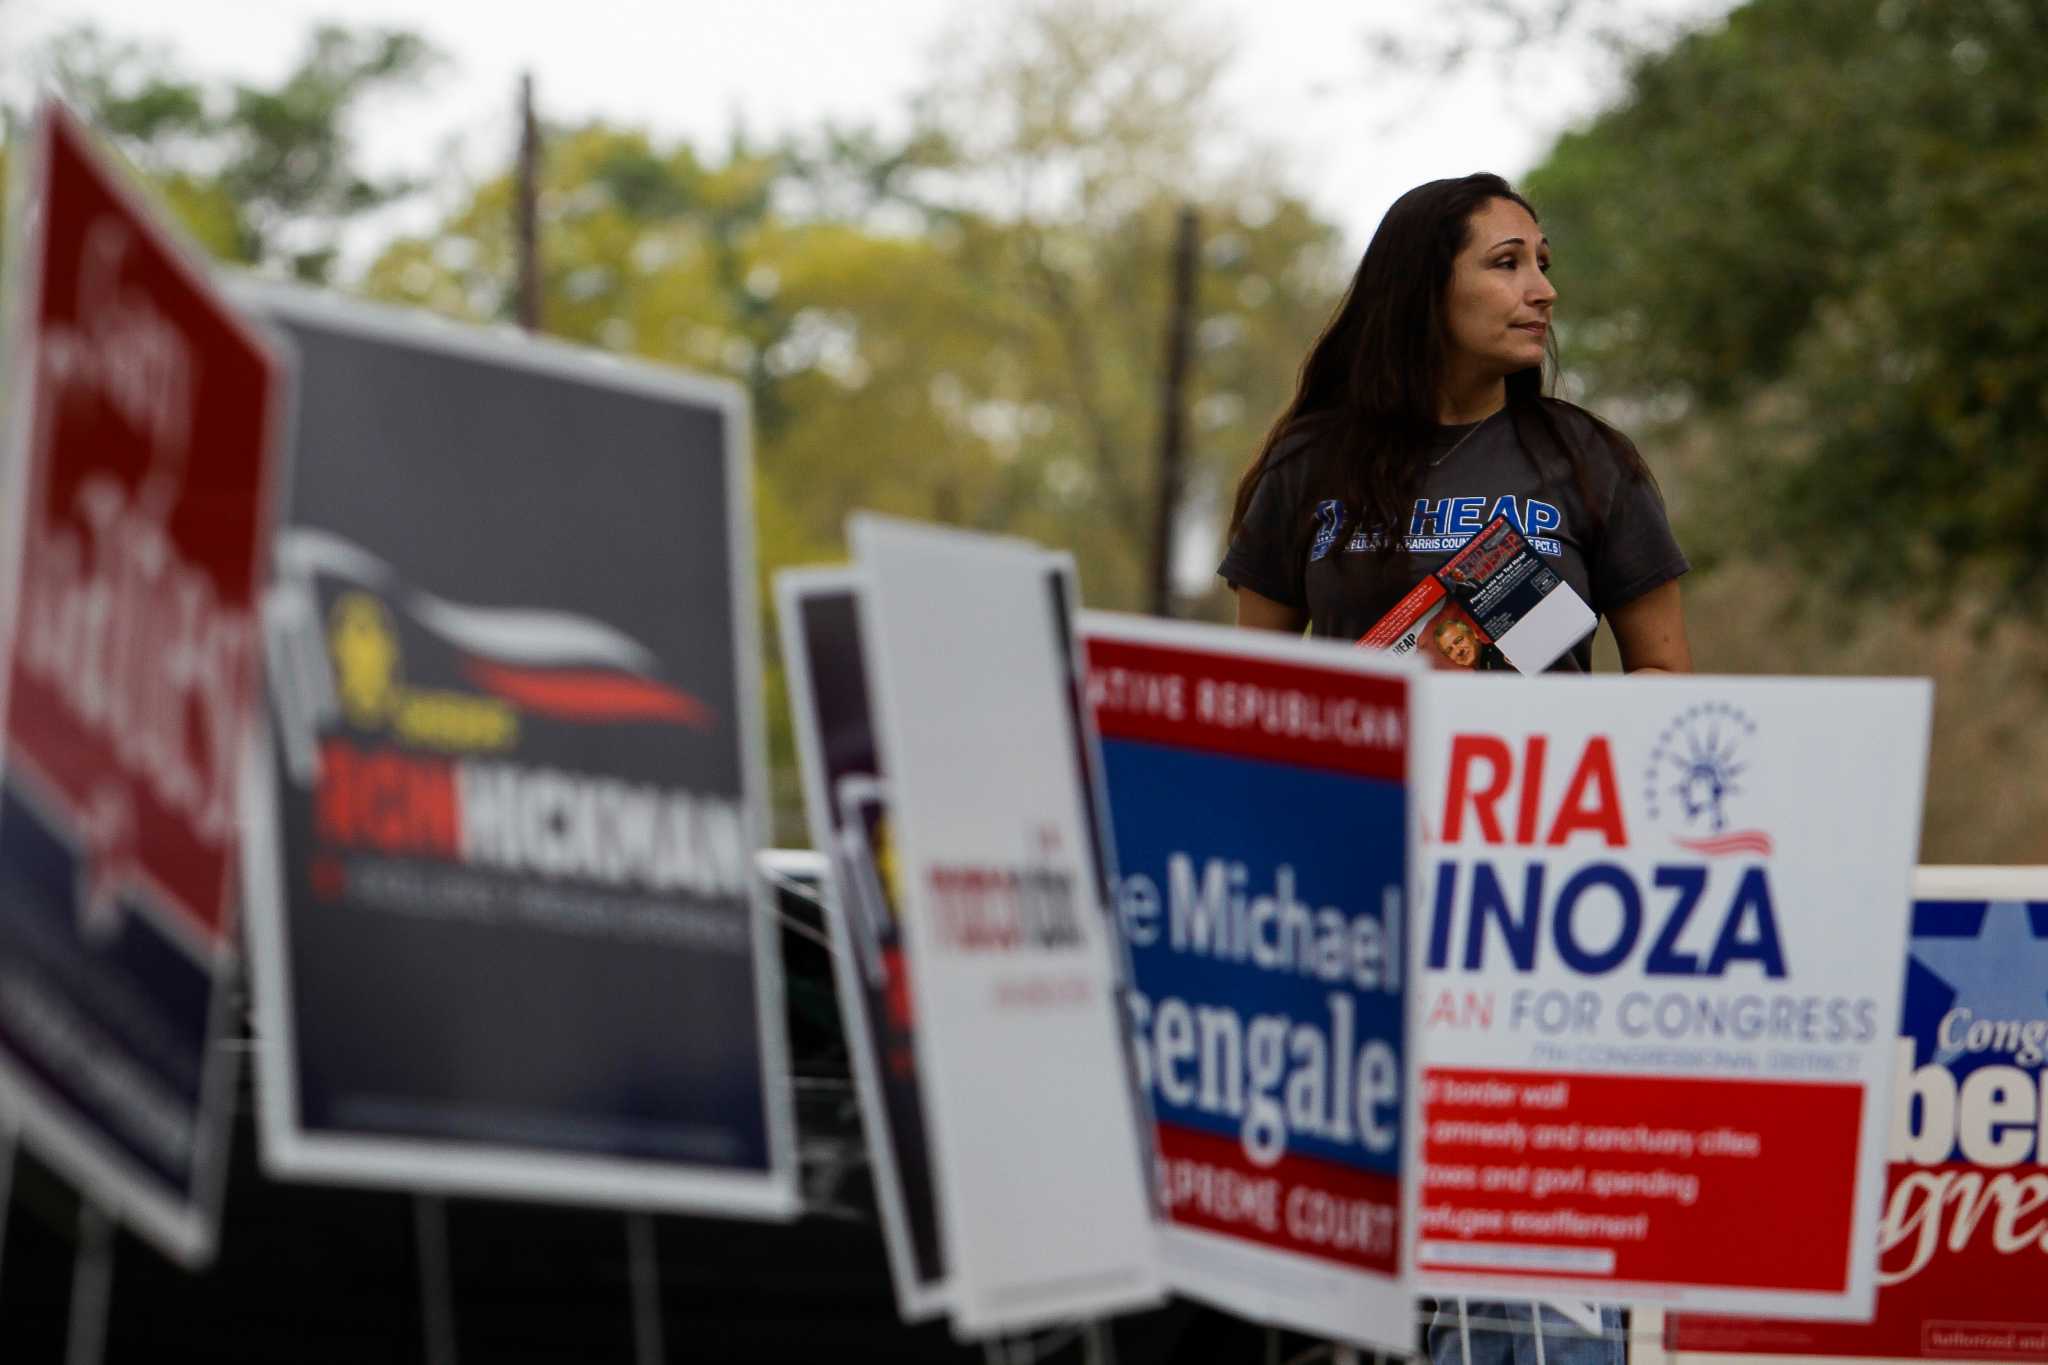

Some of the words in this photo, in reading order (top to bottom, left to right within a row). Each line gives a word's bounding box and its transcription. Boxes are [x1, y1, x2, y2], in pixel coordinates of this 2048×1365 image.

[1408, 495, 1561, 537] HEAP
[1406, 537, 1441, 550] HARRIS
[1393, 632, 1416, 656] HEAP
[1197, 678, 1402, 750] REPUBLICAN
[1422, 733, 1629, 849] RIA
[1167, 852, 1402, 995] Michael
[1424, 860, 1789, 979] INOZA
[1508, 990, 1602, 1036] FOR
[1614, 991, 1878, 1044] CONGRESS
[1937, 1007, 2048, 1068] Cong
[1577, 1045, 1758, 1070] CONGRESSIONAL
[1767, 1050, 1861, 1074] DISTRICT
[1443, 1078, 1516, 1107] border
[1520, 1081, 1570, 1110] wall
[1432, 1119, 1527, 1152] amnesty
[1531, 1122, 1581, 1150] and
[1584, 1125, 1693, 1159] sanctuary
[1697, 1129, 1762, 1157] cities
[1481, 1165, 1530, 1193] and
[1591, 1169, 1699, 1205] spending
[1285, 1183, 1395, 1256] COURT
[1420, 1204, 1503, 1239] efugee
[1510, 1208, 1650, 1241] resettlement
[1876, 1169, 2048, 1287] gre
